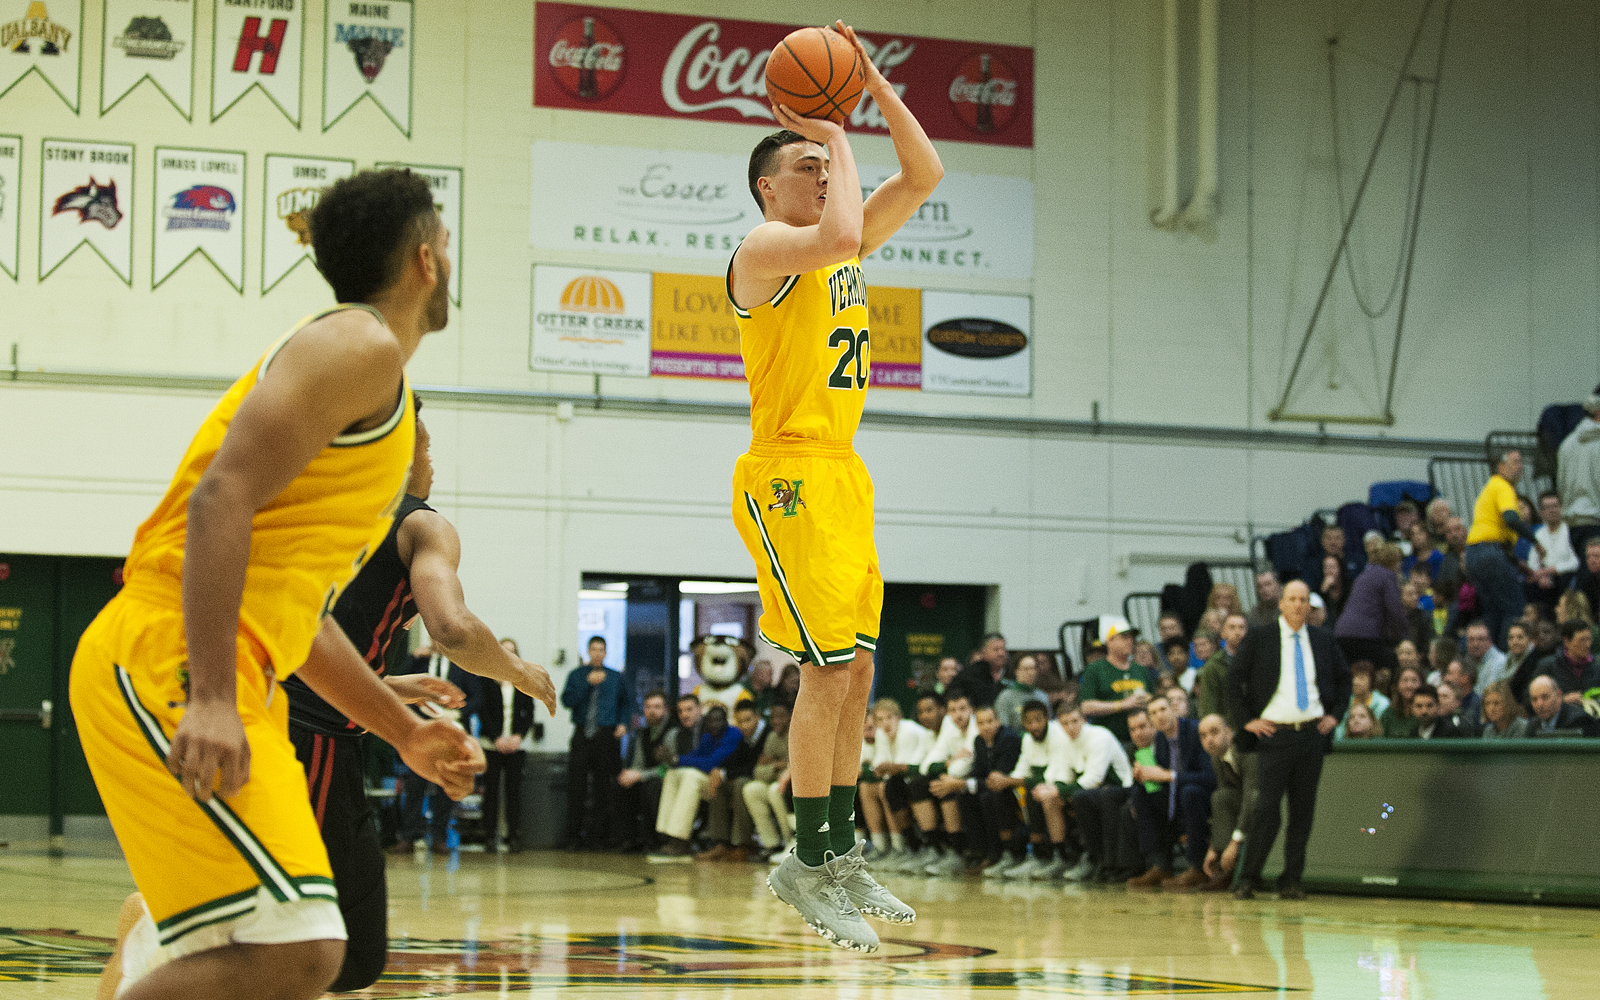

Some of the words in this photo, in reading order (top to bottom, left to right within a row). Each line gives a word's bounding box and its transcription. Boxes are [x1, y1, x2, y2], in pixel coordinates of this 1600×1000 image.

[350, 3, 389, 19] MAINE
[46, 148, 84, 162] STONY
[90, 151, 129, 165] BROOK
[162, 157, 196, 171] UMASS
[201, 160, 239, 174] LOWELL
[293, 166, 327, 179] UMBC
[573, 224, 671, 247] RELAX.
[866, 245, 992, 269] ONNECT.
[828, 264, 868, 318] VERMO
[536, 313, 587, 328] OTTER
[593, 316, 645, 331] CREEK
[656, 319, 699, 342] LIKE
[827, 326, 871, 391] 20
